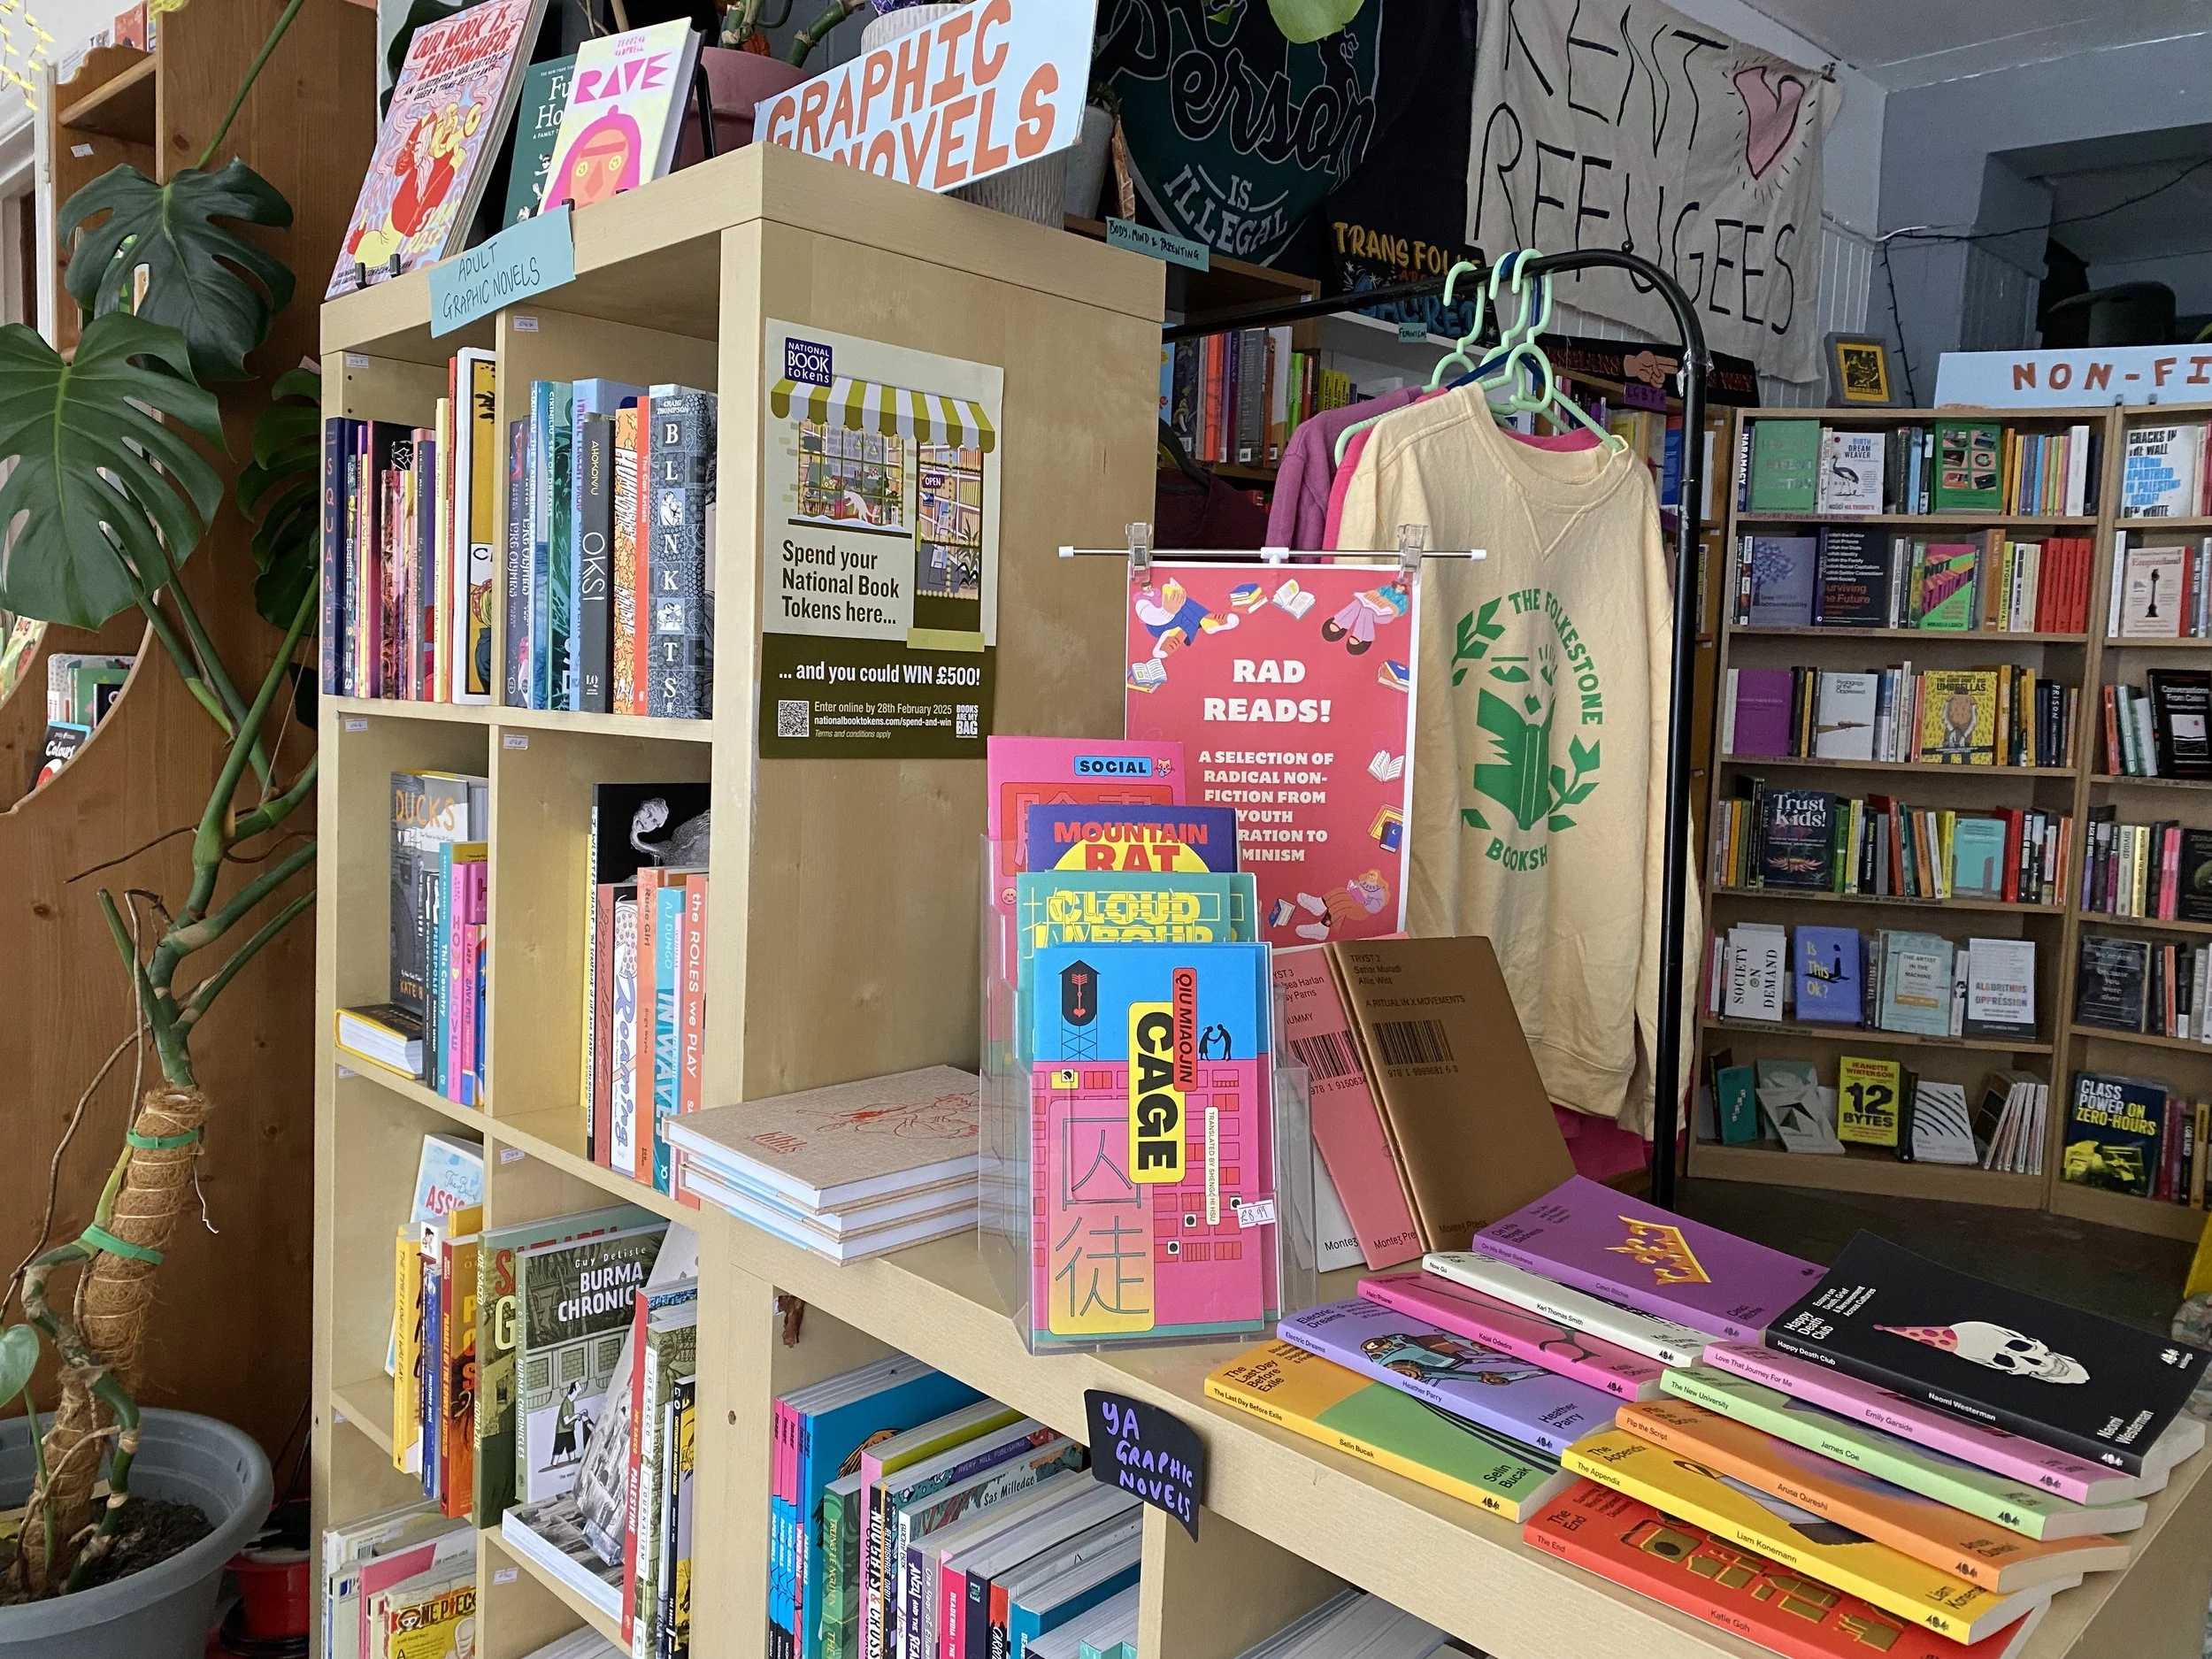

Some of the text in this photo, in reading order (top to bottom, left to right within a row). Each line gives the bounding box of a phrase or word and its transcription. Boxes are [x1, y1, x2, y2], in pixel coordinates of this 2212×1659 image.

[412, 3, 511, 60] OUR WORK IS
[418, 22, 517, 81] EVERYWHERE
[574, 52, 672, 104] RAVE
[766, 0, 1012, 152] GRAPHIC
[1227, 174, 1253, 211] IS
[1163, 165, 1288, 257] ILLEGAL
[1474, 101, 1796, 335] REFUGEES
[1132, 227, 1149, 243] MIND
[1160, 237, 1200, 261] PARENTING
[1333, 222, 1409, 267] TRANS
[457, 242, 498, 280] ADULT
[442, 257, 541, 319] GRAPHIC NOVELS
[787, 350, 829, 373] BOOK
[788, 342, 829, 357] NATIONAL
[787, 367, 830, 384] tokens
[2012, 356, 2212, 391] NON-FI
[2129, 432, 2165, 444] CRACKS
[590, 440, 600, 495] AHOKOIVU
[1738, 433, 1749, 485] HARAMACY
[925, 477, 941, 487] OPEN
[324, 458, 334, 625] SQUARE
[782, 540, 878, 571] Spend your
[581, 532, 606, 601] OKSI
[782, 568, 899, 598] National Book
[782, 595, 896, 625] Tokens here...
[1233, 659, 1306, 683] RAD
[1508, 588, 1603, 726] THE FOLKESTONE
[796, 662, 825, 680] and
[829, 667, 855, 685] you
[860, 664, 899, 683] could
[902, 665, 933, 684] WIN
[936, 666, 980, 687] £500!
[1936, 683, 1986, 693] UMBRELLAS
[814, 702, 952, 716] Enter online by 28th February 2025
[814, 716, 952, 727] nationalbooktokens.com/spend-and-win
[1203, 698, 1332, 723] READS!
[815, 729, 833, 738] Terms
[876, 731, 891, 740] apply
[956, 721, 978, 735] BAG
[46, 741, 75, 759] Colours
[1199, 751, 1334, 765] A SELECTION OF
[1079, 760, 1147, 773] SOCIAL
[1203, 771, 1328, 784] RADICAL NON-
[396, 789, 456, 831] DUCKS
[1204, 789, 1326, 803] FICTION FROM
[1773, 795, 1825, 812] Trust
[1238, 810, 1294, 823] YOUTH
[1775, 807, 1826, 828] Kids!
[1054, 822, 1208, 844] MOUNTAIN
[1239, 828, 1328, 842] RATION TO
[1085, 844, 1180, 872] RAT
[1242, 849, 1305, 862] MINISM
[1485, 837, 1548, 872] BOOKSH
[1048, 890, 1201, 925] CLOUD
[1807, 941, 1816, 956] Is
[1733, 945, 1748, 1004] SOCIETY
[1750, 967, 1762, 987] ON
[1763, 949, 1778, 1009] DEMAND
[1808, 960, 1829, 979] This
[1905, 972, 1932, 980] MACHINE
[687, 893, 702, 1079] the ROLES we PLAY
[1807, 982, 1829, 998] Ok?
[1975, 982, 2027, 995] ALGORITHMS
[1975, 995, 2028, 1008] OPPRESSION
[1176, 973, 1192, 1083] QIU MIAOJIN
[615, 973, 636, 1148] Roaming
[655, 993, 674, 1136] IN WAVES
[1136, 1011, 1179, 1171] CAGE
[1845, 1082, 1896, 1115] 12
[2081, 1079, 2123, 1101] CLASS
[2078, 1094, 2147, 1118] POWER ON
[1843, 1113, 1893, 1128] BYTES
[2076, 1107, 2156, 1136] ZERO-HOURS
[1209, 1156, 1215, 1166] BY
[1240, 1205, 1269, 1223] £8.99
[575, 1246, 647, 1268] Guy Delisle
[580, 1261, 643, 1294] BURMA
[557, 1286, 640, 1322] CHRONIC
[1286, 1332, 1325, 1354] Electric Dreams
[1778, 1340, 1836, 1365] Happy Death Club
[1671, 1381, 1729, 1409] The New University
[1928, 1392, 1996, 1422] Naomi Westerman
[1102, 1402, 1140, 1440] YA
[1340, 1439, 1374, 1458] Selin Bucak
[1115, 1440, 1193, 1488] GRAPHIC
[1577, 1462, 1620, 1486] The Appendix
[628, 1466, 637, 1535] PALESTINE
[984, 1477, 1035, 1506] Sas Milledge
[1119, 1470, 1191, 1523] NOVELS
[1737, 1531, 1797, 1563] Liam Konemann
